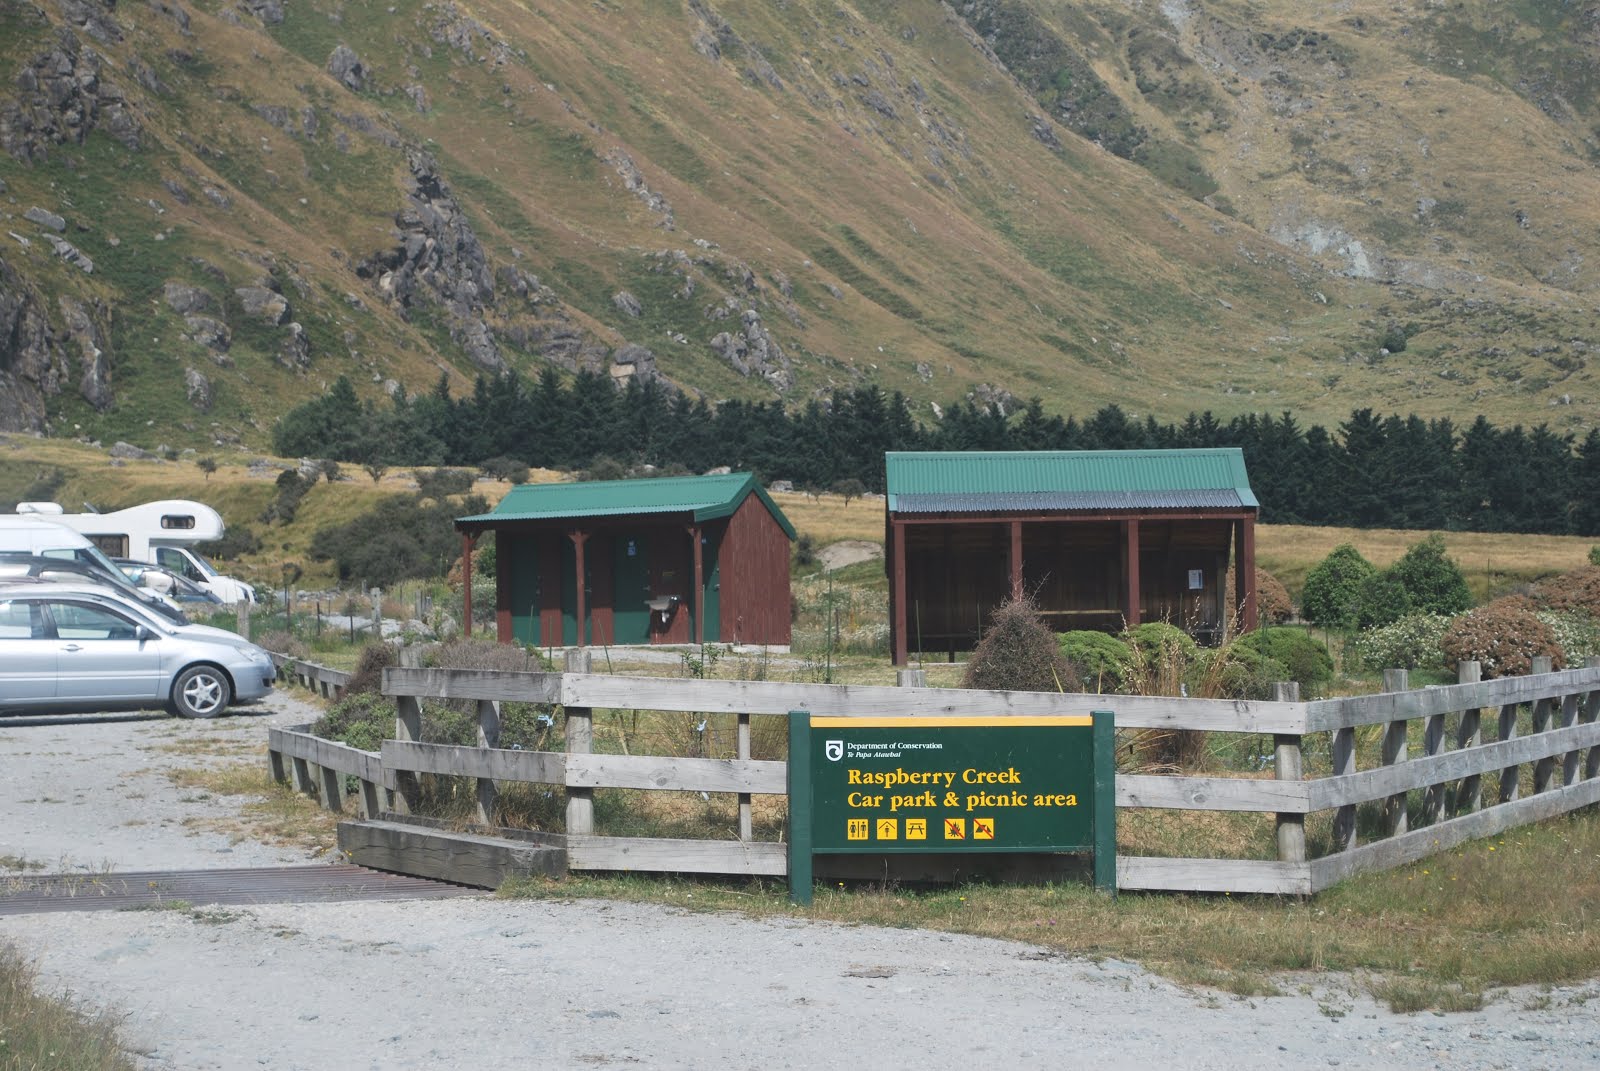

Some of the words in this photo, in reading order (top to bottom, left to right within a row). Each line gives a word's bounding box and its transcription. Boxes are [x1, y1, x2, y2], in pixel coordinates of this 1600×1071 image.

[847, 742, 888, 751] Department
[856, 751, 872, 759] Papa
[847, 768, 956, 788] Raspberry
[962, 767, 1021, 784] Creek
[847, 791, 883, 807] Car
[890, 791, 937, 812] park
[943, 792, 960, 807] &
[966, 790, 1028, 812] picnic
[1033, 794, 1078, 807] area
